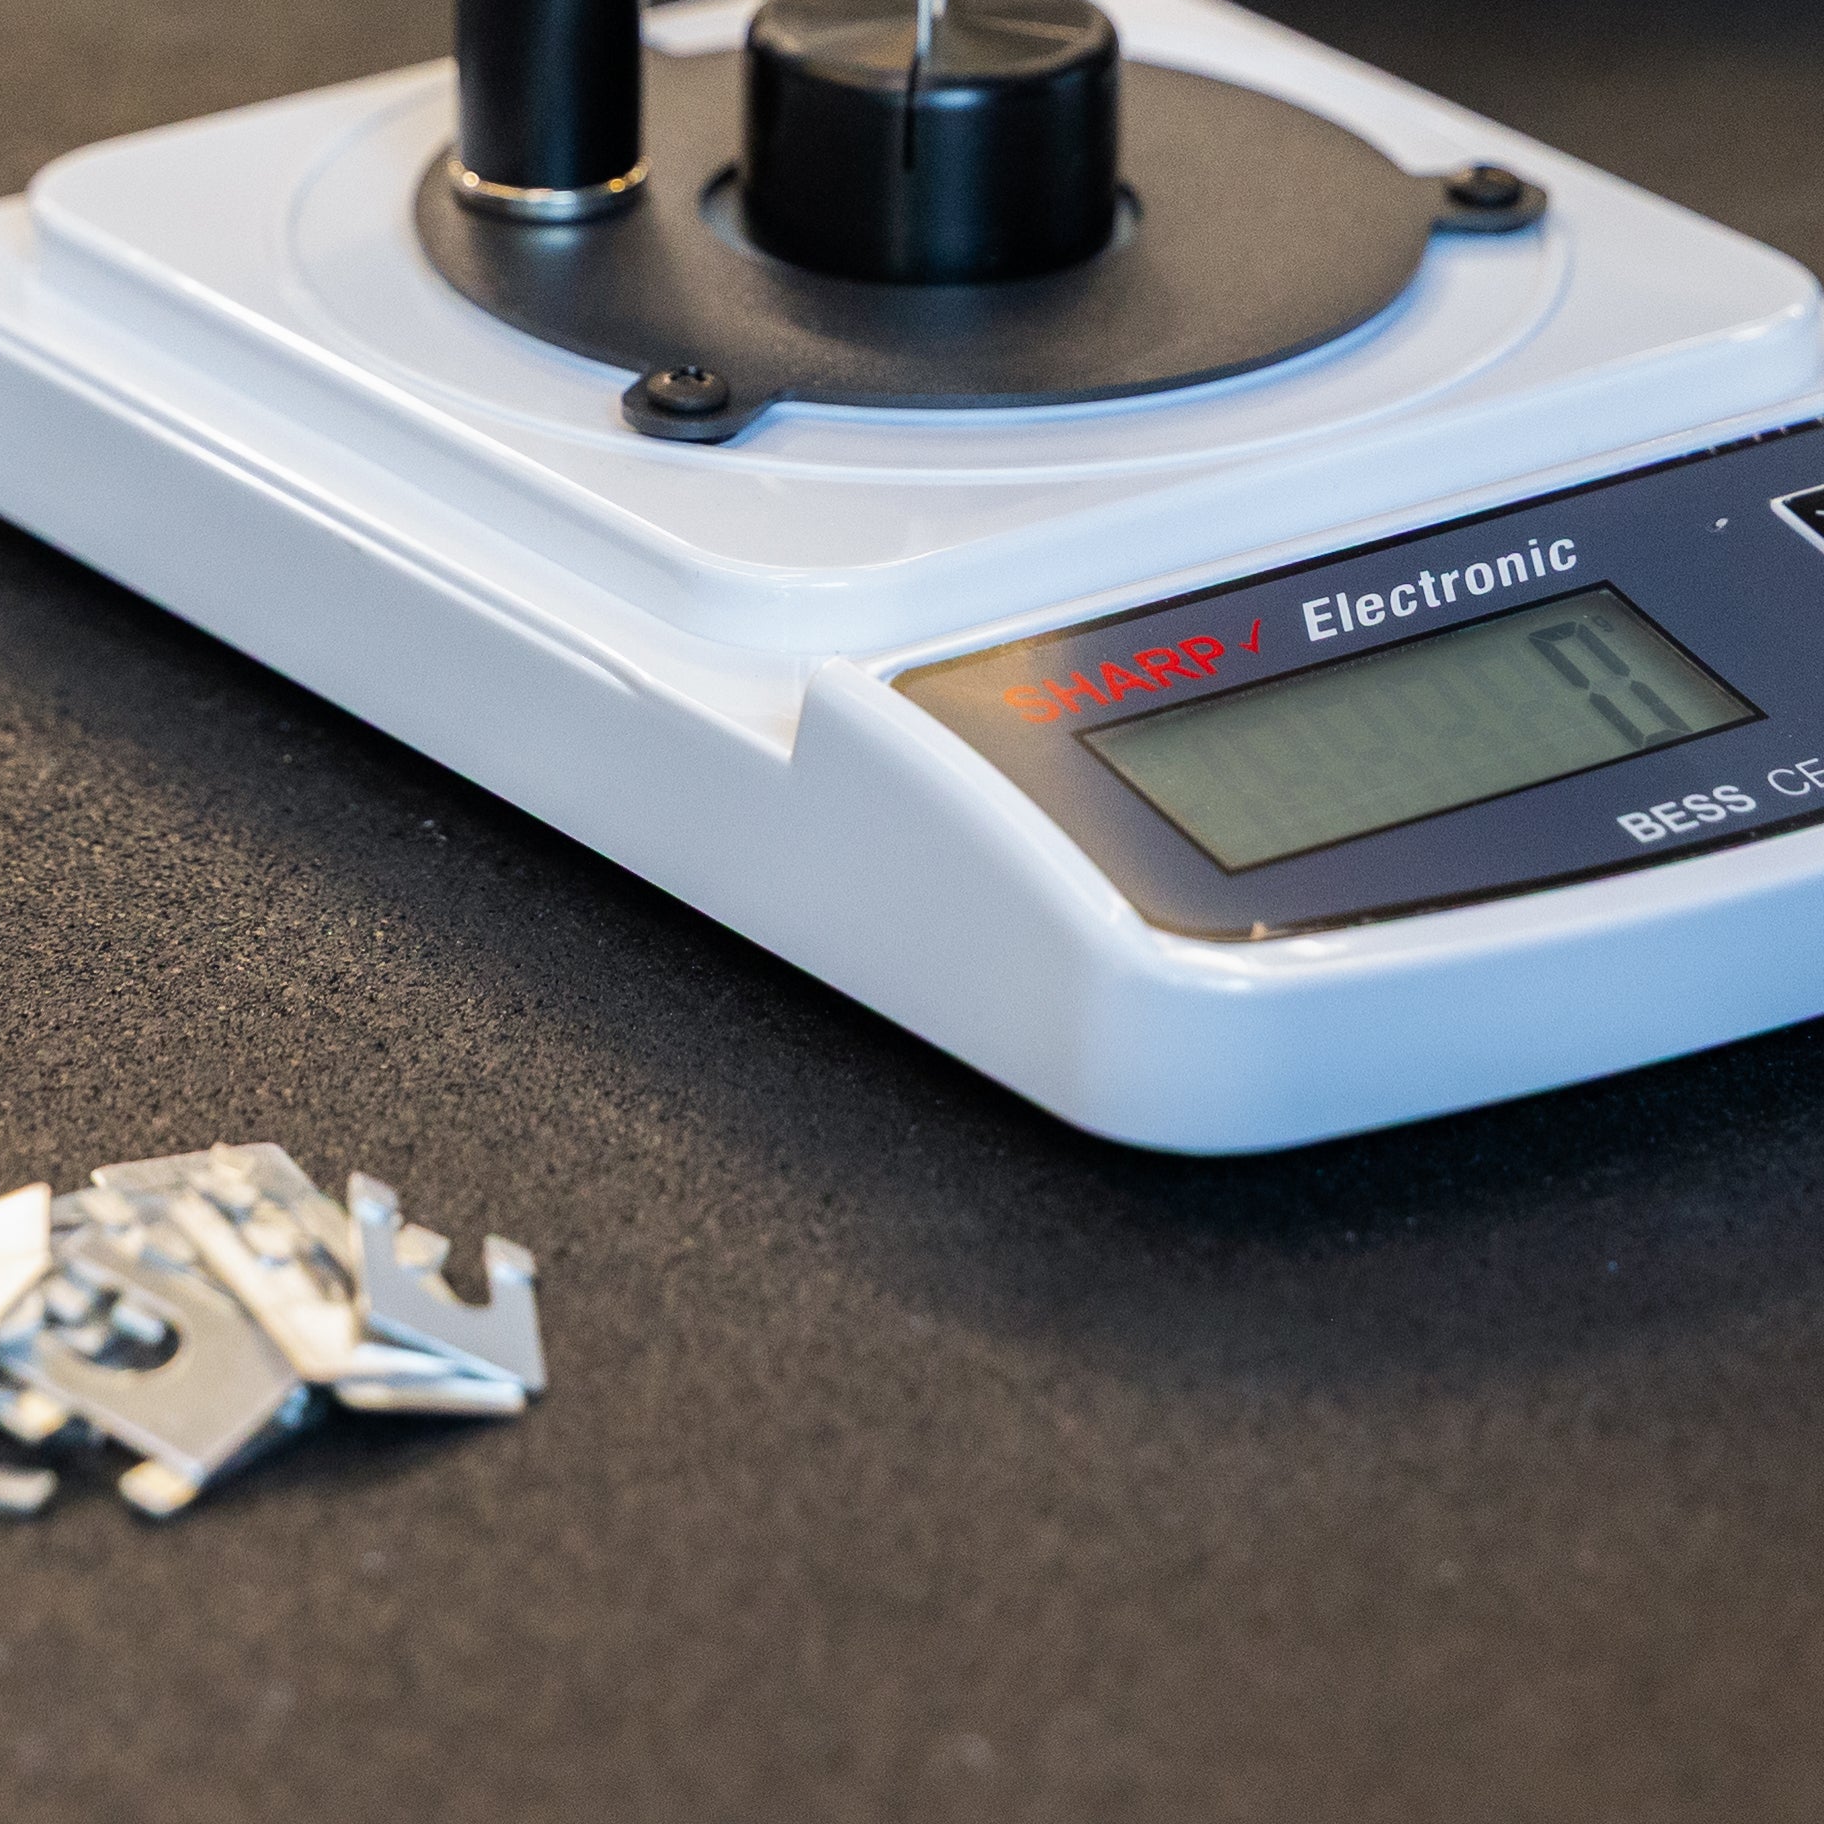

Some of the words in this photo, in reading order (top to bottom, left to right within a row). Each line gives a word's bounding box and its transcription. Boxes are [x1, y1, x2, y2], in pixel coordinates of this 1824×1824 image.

[1003, 635, 1226, 723] SHARP
[1302, 538, 1578, 642] Electronic
[1616, 784, 1757, 844] BESS
